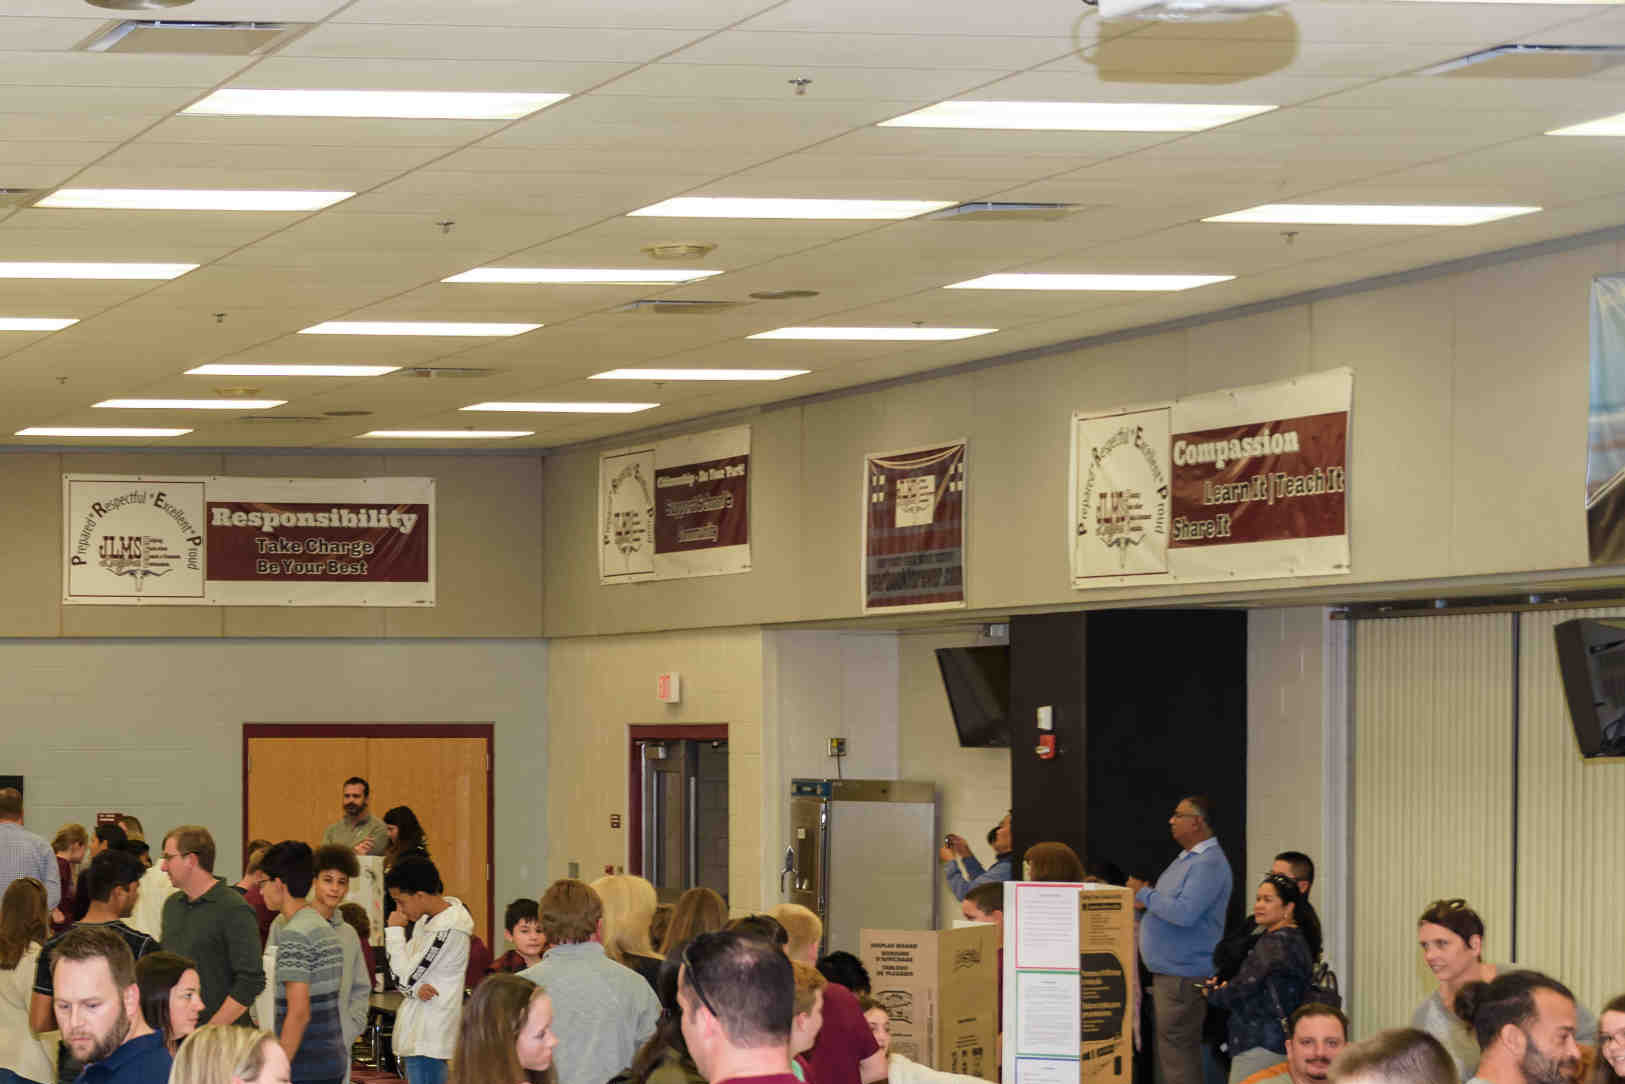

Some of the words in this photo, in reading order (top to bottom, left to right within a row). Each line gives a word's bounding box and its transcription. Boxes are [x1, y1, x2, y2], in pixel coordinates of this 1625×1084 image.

[1174, 431, 1300, 469] Compassion
[1203, 481, 1248, 505] Learn
[1250, 475, 1267, 500] It
[1276, 468, 1325, 499] Teach
[1327, 466, 1345, 493] It
[211, 508, 418, 535] Responsibility
[1173, 517, 1213, 541] Share
[1214, 513, 1231, 538] It
[99, 535, 142, 560] JLMS
[255, 537, 303, 555] Take
[303, 538, 375, 558] Charge
[256, 559, 279, 575] Be
[281, 559, 325, 576] Your
[326, 561, 368, 576] Best
